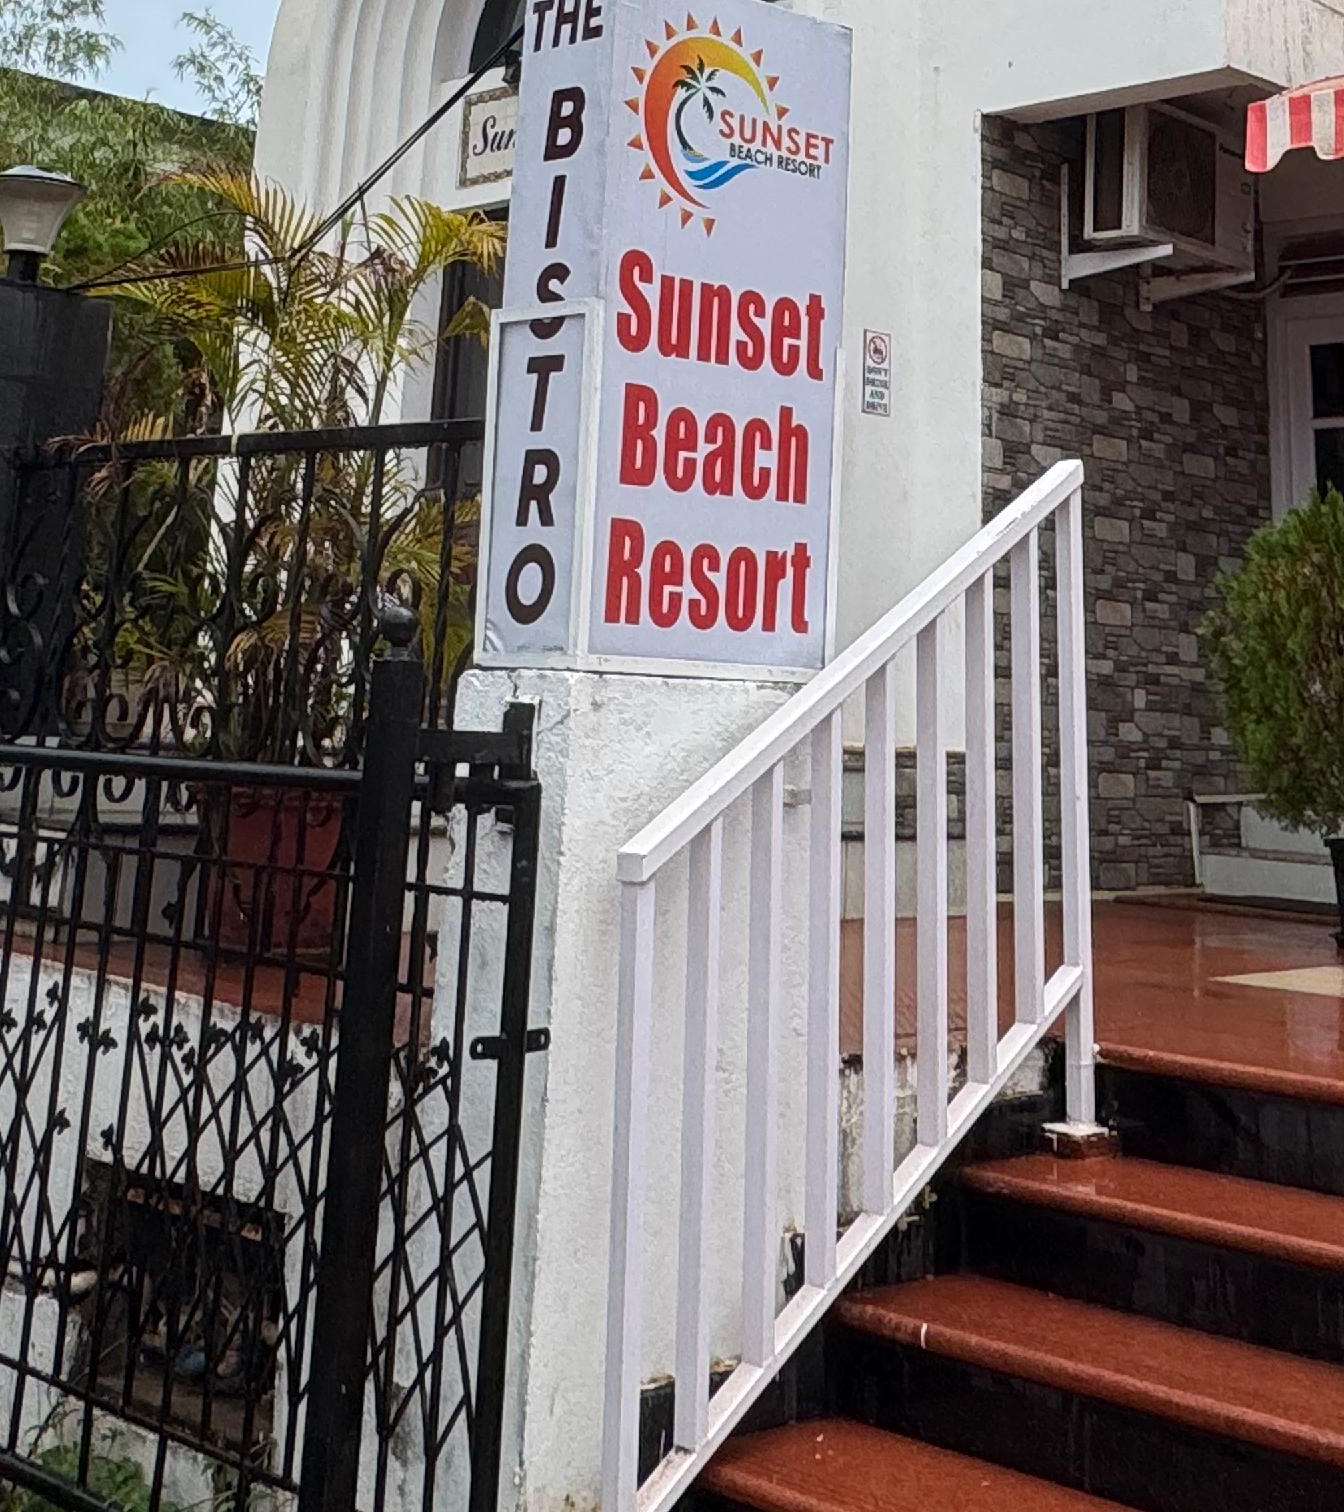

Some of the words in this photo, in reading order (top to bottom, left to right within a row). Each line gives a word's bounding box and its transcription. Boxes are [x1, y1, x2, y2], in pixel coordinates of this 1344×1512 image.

[719, 109, 834, 165] SUNSET
[729, 143, 773, 168] BEACH
[777, 155, 822, 180] RESORT
[505, 87, 586, 625] BISTRO
[617, 249, 825, 381] Sunset
[619, 382, 809, 504] Beach
[604, 517, 811, 634] Resort
